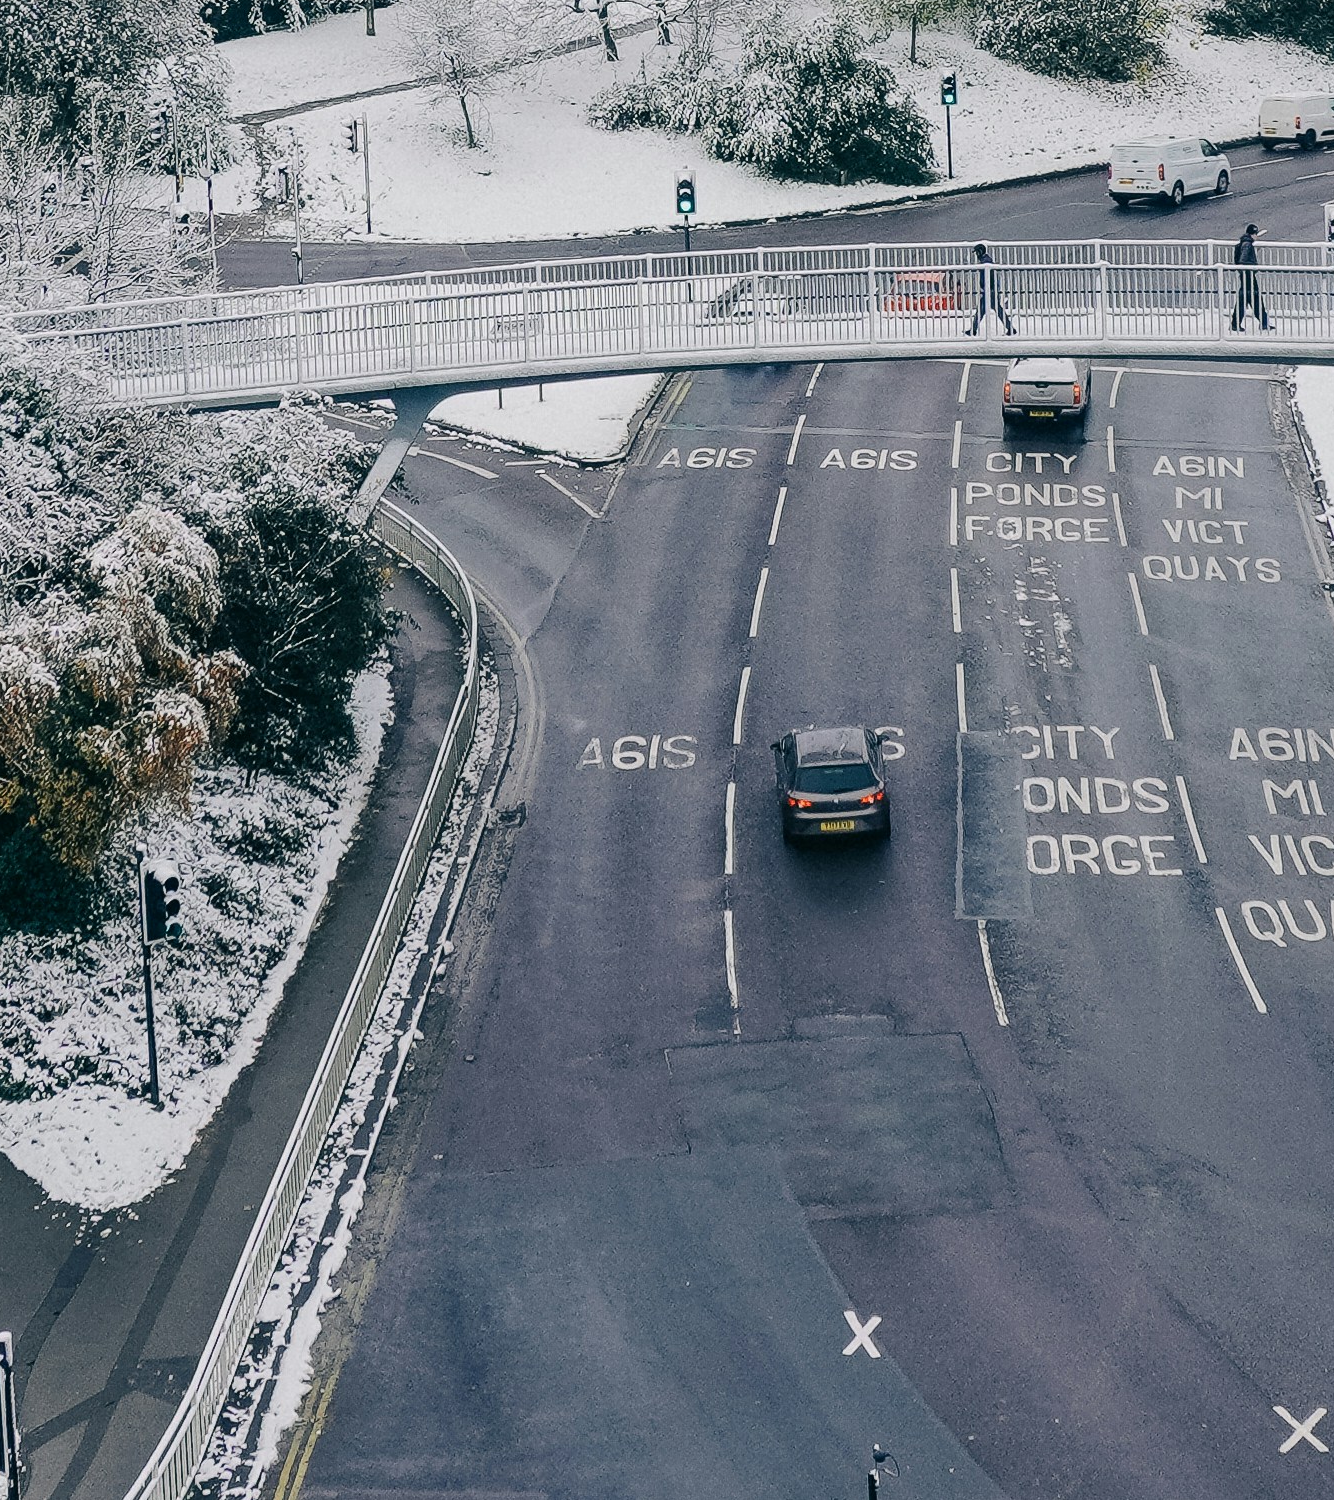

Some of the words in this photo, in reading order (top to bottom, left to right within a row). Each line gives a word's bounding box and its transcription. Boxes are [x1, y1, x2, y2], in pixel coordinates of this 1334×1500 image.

[985, 452, 1077, 474] CITY
[966, 482, 1106, 507] PONDS
[965, 516, 1110, 543] FORGE
[1161, 519, 1249, 545] VICT
[1142, 555, 1282, 583] QUAYS
[1011, 725, 1121, 760] CITY
[1019, 776, 1170, 815] ONDS
[1025, 833, 1183, 876] ORGE
